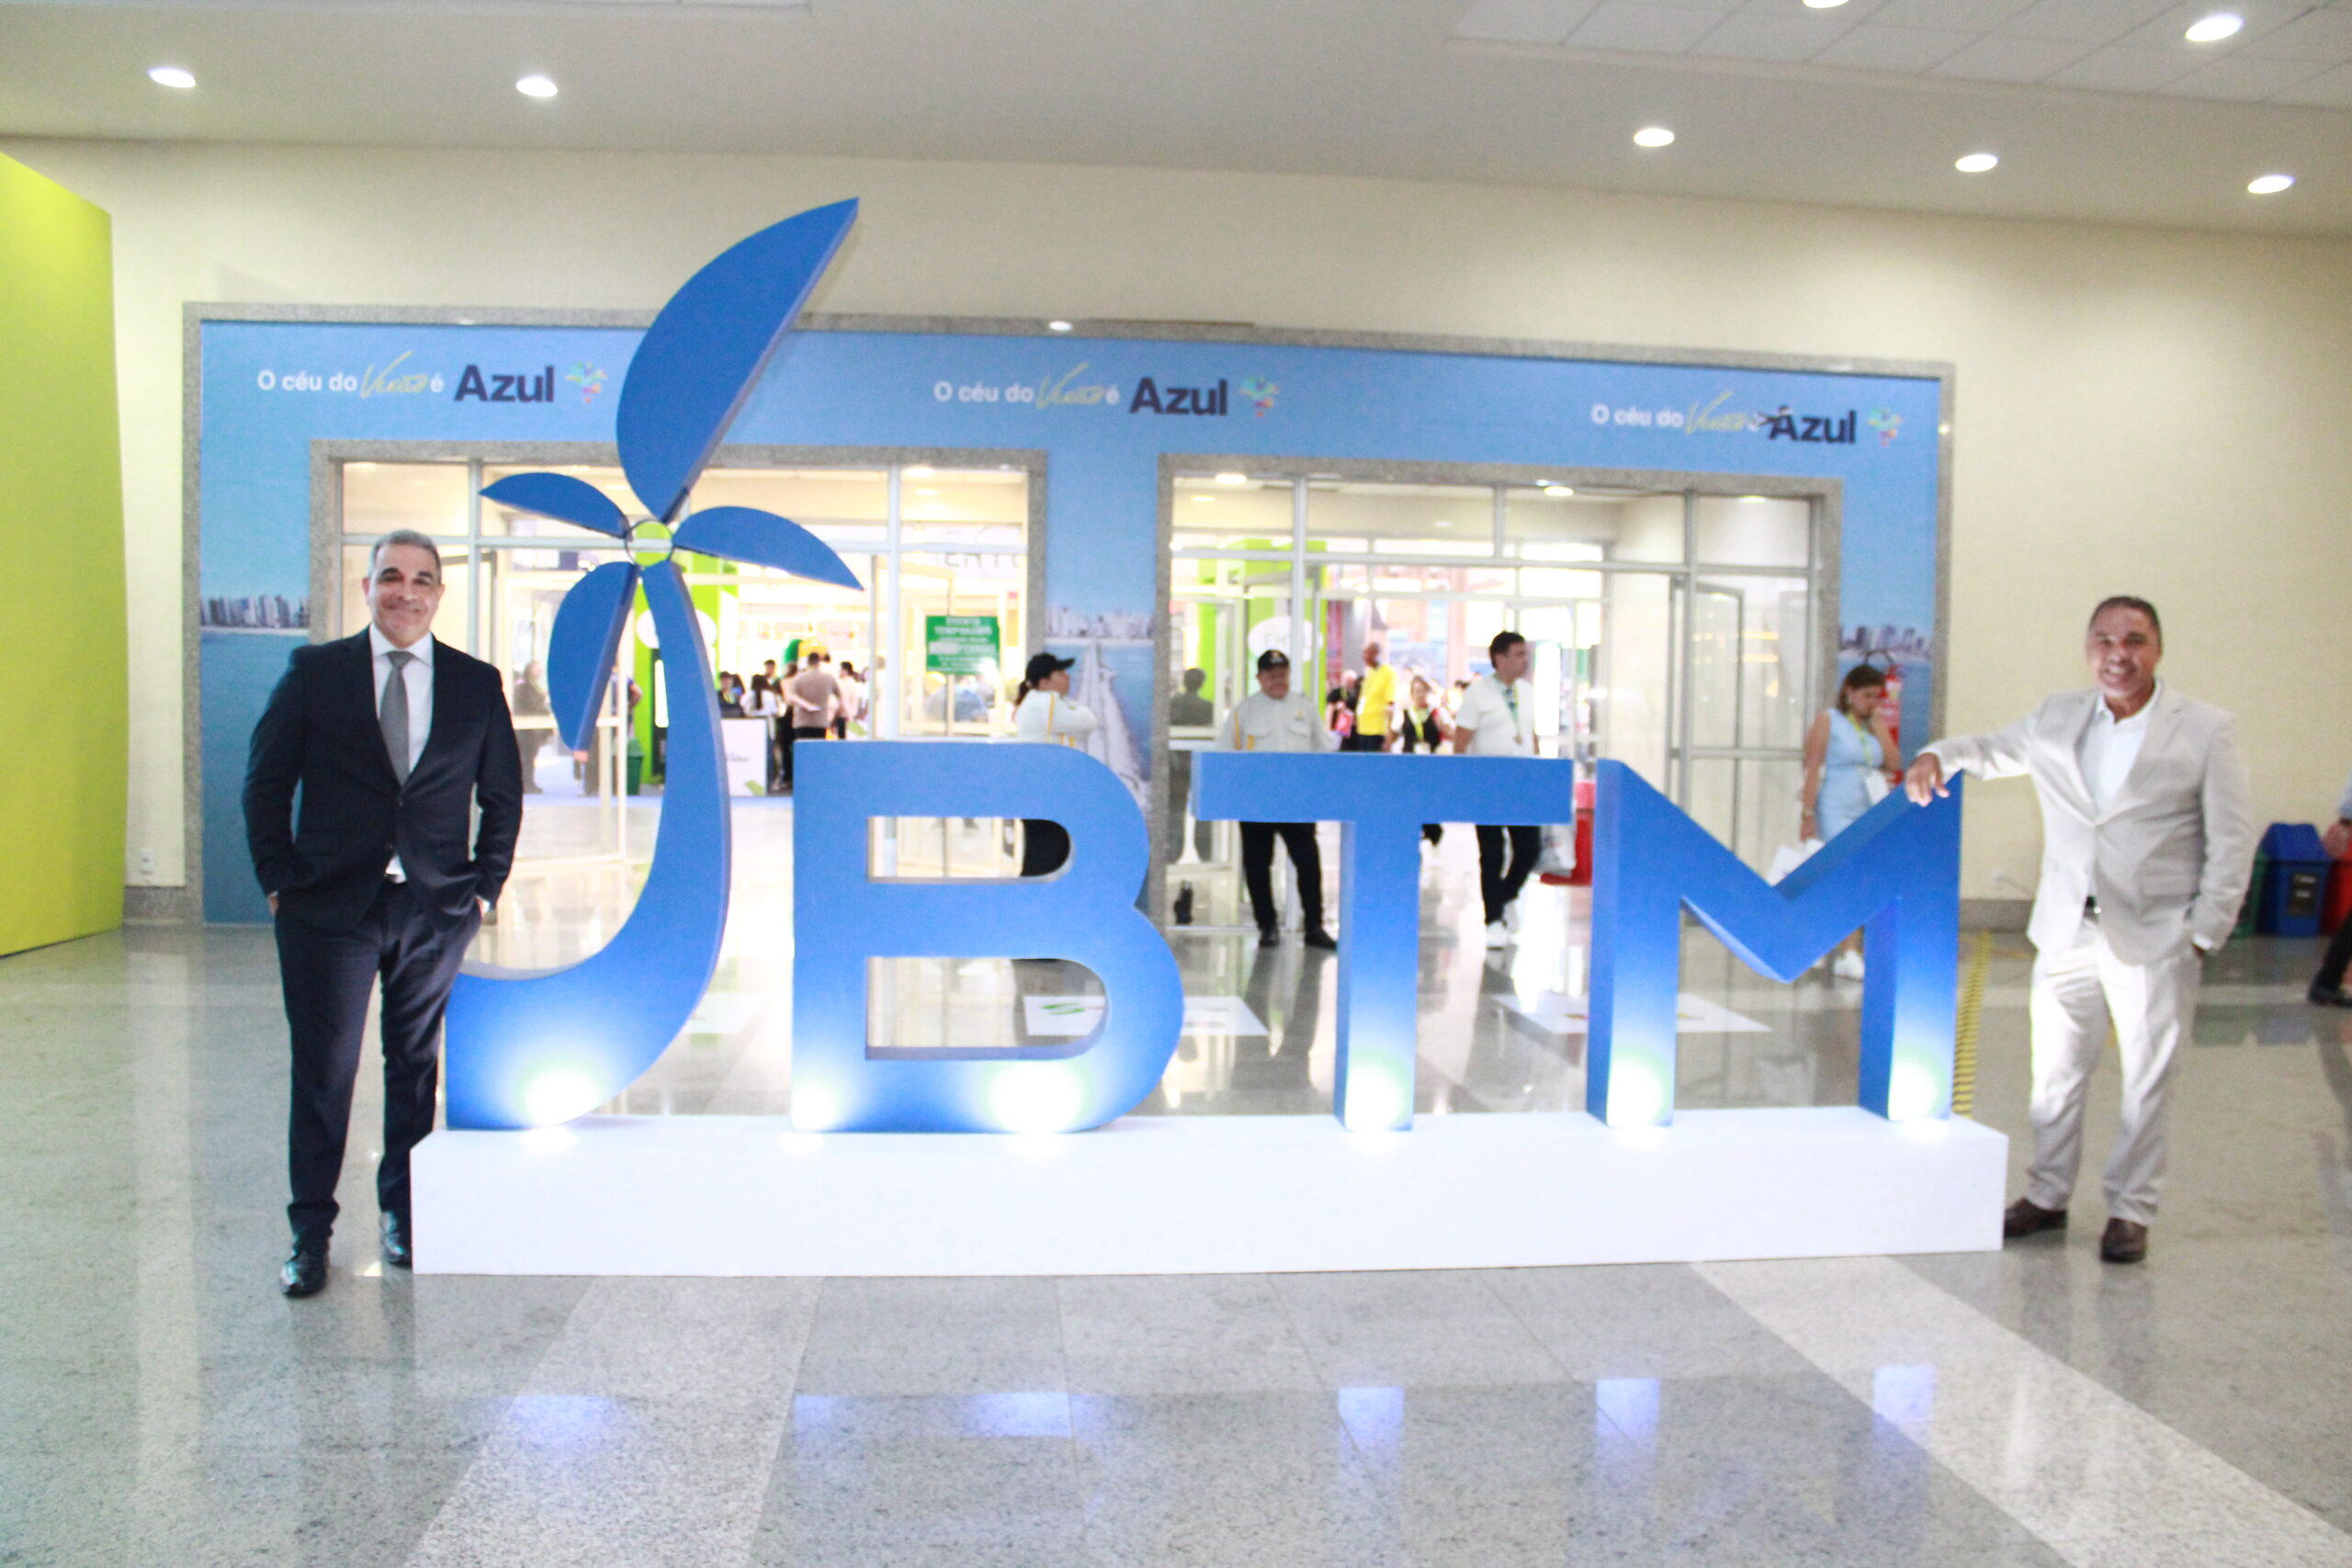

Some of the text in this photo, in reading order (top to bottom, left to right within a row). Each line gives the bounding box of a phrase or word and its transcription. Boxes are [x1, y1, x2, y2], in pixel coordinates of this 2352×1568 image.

[257, 368, 276, 391] O
[282, 367, 322, 391] céu
[328, 369, 357, 392] do
[430, 373, 445, 393] é
[454, 365, 555, 402] Azul
[933, 380, 953, 402] O
[958, 380, 1000, 403] céu
[1005, 381, 1034, 403] do
[1105, 384, 1121, 405] é
[1129, 377, 1228, 416] Azul
[1590, 403, 1609, 424] O
[1614, 405, 1652, 426] céu
[1657, 406, 1683, 428] do
[1768, 406, 1857, 445] Azul
[791, 738, 1962, 1135] BTM
